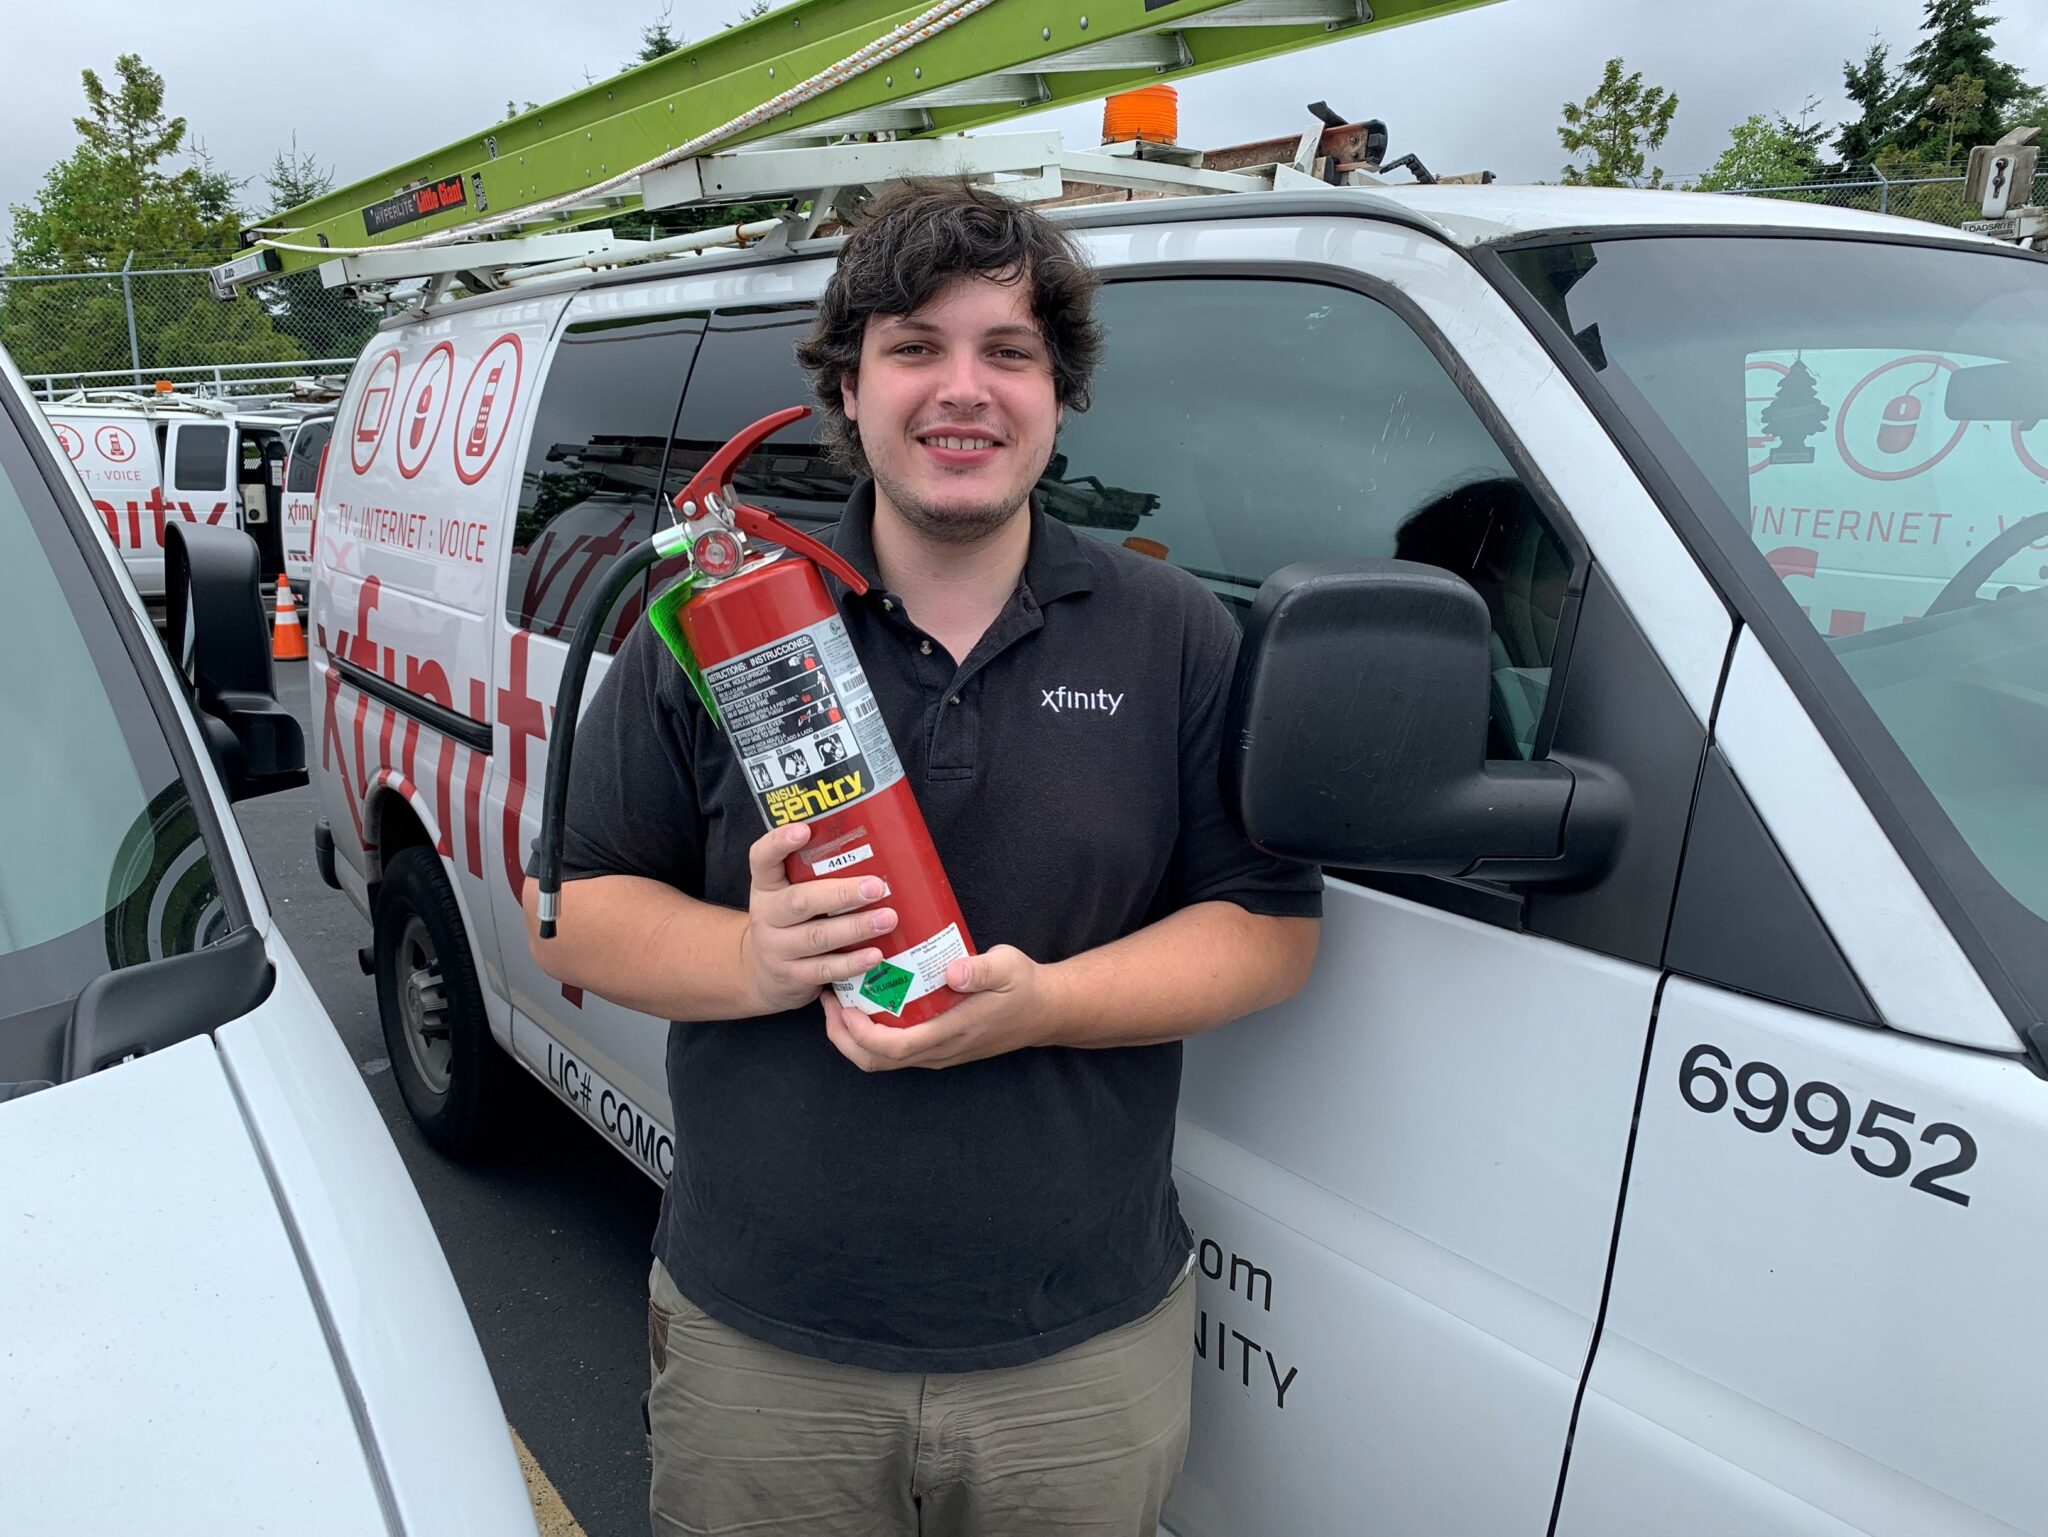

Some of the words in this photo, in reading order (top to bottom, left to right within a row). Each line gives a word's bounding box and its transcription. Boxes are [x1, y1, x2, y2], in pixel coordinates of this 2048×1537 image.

[374, 201, 414, 225] HYPERLITE
[415, 186, 440, 214] Little
[437, 178, 464, 207] Giant
[103, 470, 142, 481] VOICE
[338, 503, 353, 535] TV
[360, 506, 427, 551] INTERNET
[439, 518, 488, 563] VOICE
[1750, 504, 1953, 546] INTERNET
[749, 636, 810, 666] INSTRUCCIONES:
[731, 675, 745, 685] HOLD
[744, 666, 770, 680] UPRIGHT.
[768, 706, 783, 716] FUEGO
[1041, 686, 1124, 716] xfinity
[784, 733, 796, 742] LADO
[800, 726, 813, 735] LADO
[766, 784, 804, 805] ANSUL
[770, 770, 862, 826] sentry
[828, 854, 856, 868] 4415
[548, 1043, 592, 1112] LIC#
[600, 1089, 674, 1180] COMC
[1678, 1043, 1978, 1208] 69952
[1192, 1230, 1273, 1312] om
